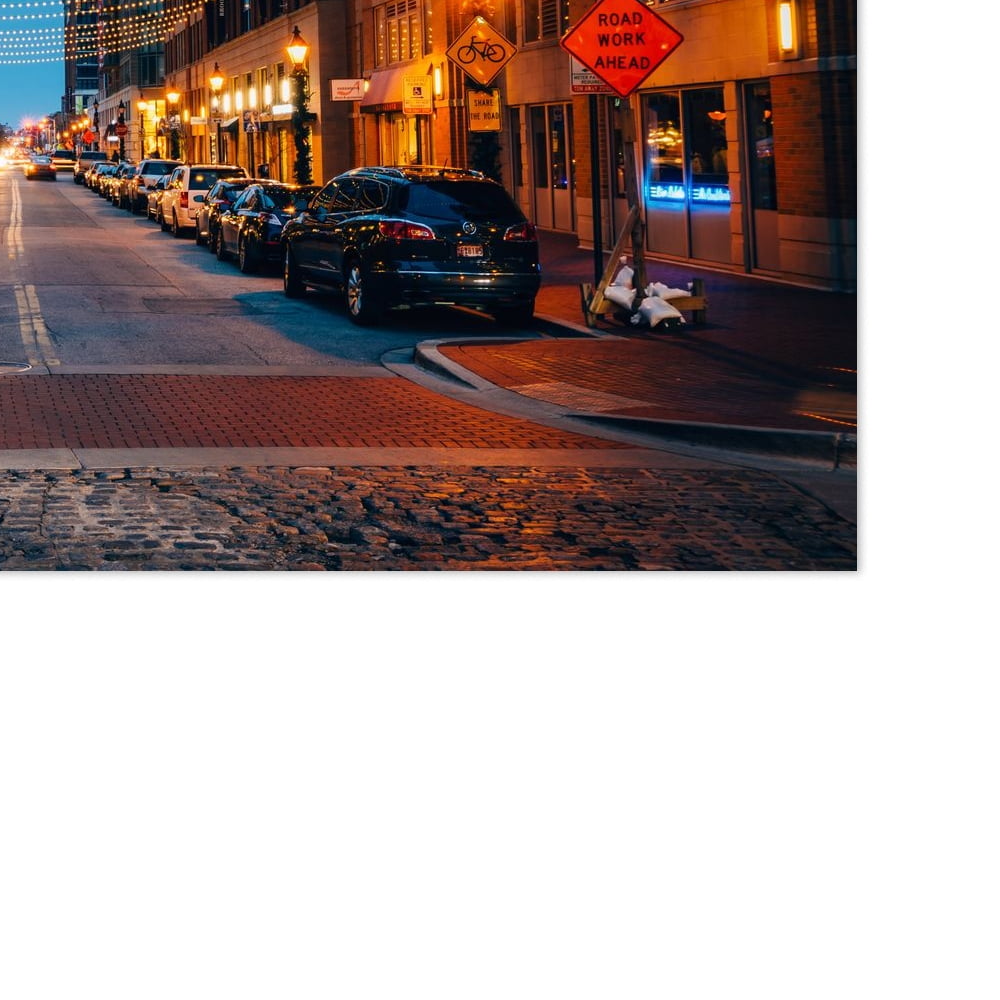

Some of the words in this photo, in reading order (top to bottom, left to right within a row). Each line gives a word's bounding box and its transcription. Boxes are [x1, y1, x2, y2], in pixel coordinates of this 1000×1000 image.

[598, 12, 643, 27] ROAD
[598, 32, 645, 47] WORK
[594, 56, 650, 70] AHEAD
[474, 98, 493, 106] SHARE
[470, 112, 480, 120] THE
[483, 112, 500, 120] ROAD
